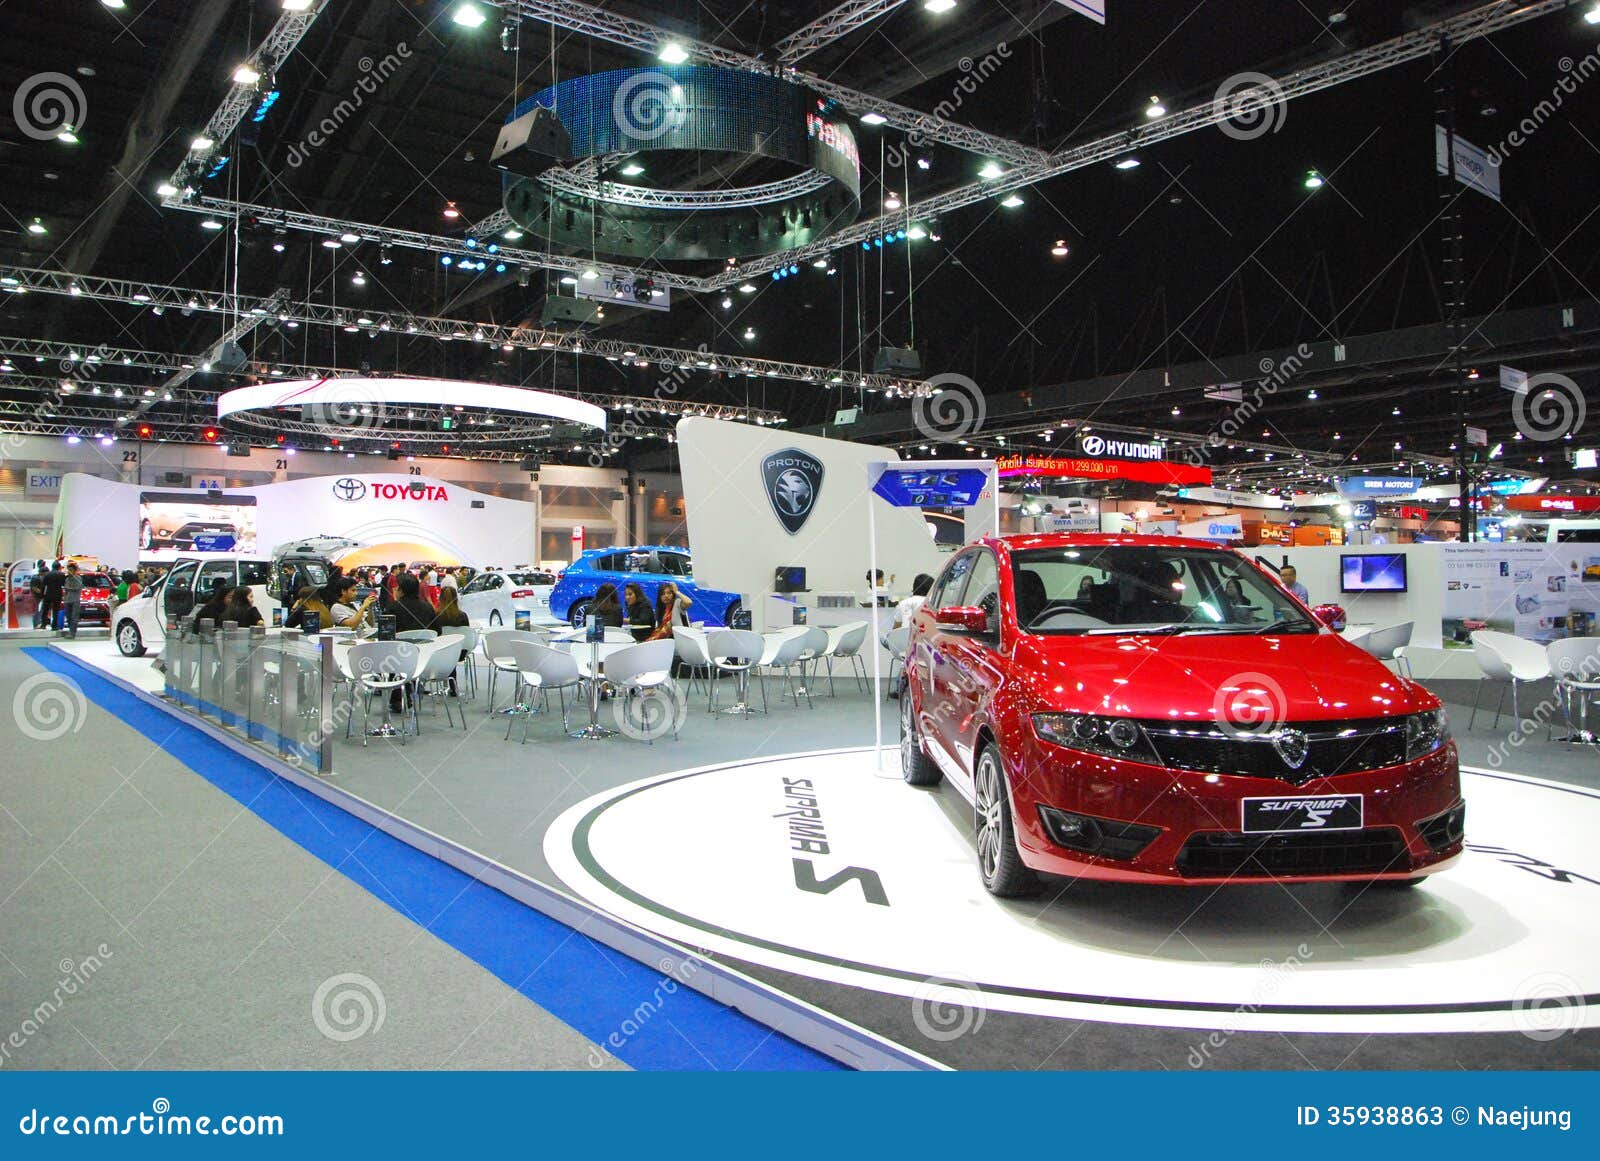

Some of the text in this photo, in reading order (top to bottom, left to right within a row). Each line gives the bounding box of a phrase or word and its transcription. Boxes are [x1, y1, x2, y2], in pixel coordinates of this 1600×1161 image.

[1562, 308, 1574, 328] N
[123, 451, 137, 462] 22
[1106, 440, 1162, 460] HYUNDAI
[276, 459, 288, 469] 21
[767, 458, 821, 474] PROTON
[30, 475, 60, 487] EXIT
[530, 473, 539, 482] 19
[1385, 480, 1414, 489] MOTORS
[371, 483, 449, 501] TOYOTA
[1258, 799, 1348, 812] SUPRIMA
[772, 776, 830, 855] SUPRIMA
[1300, 809, 1333, 828] S
[792, 857, 891, 907] S
